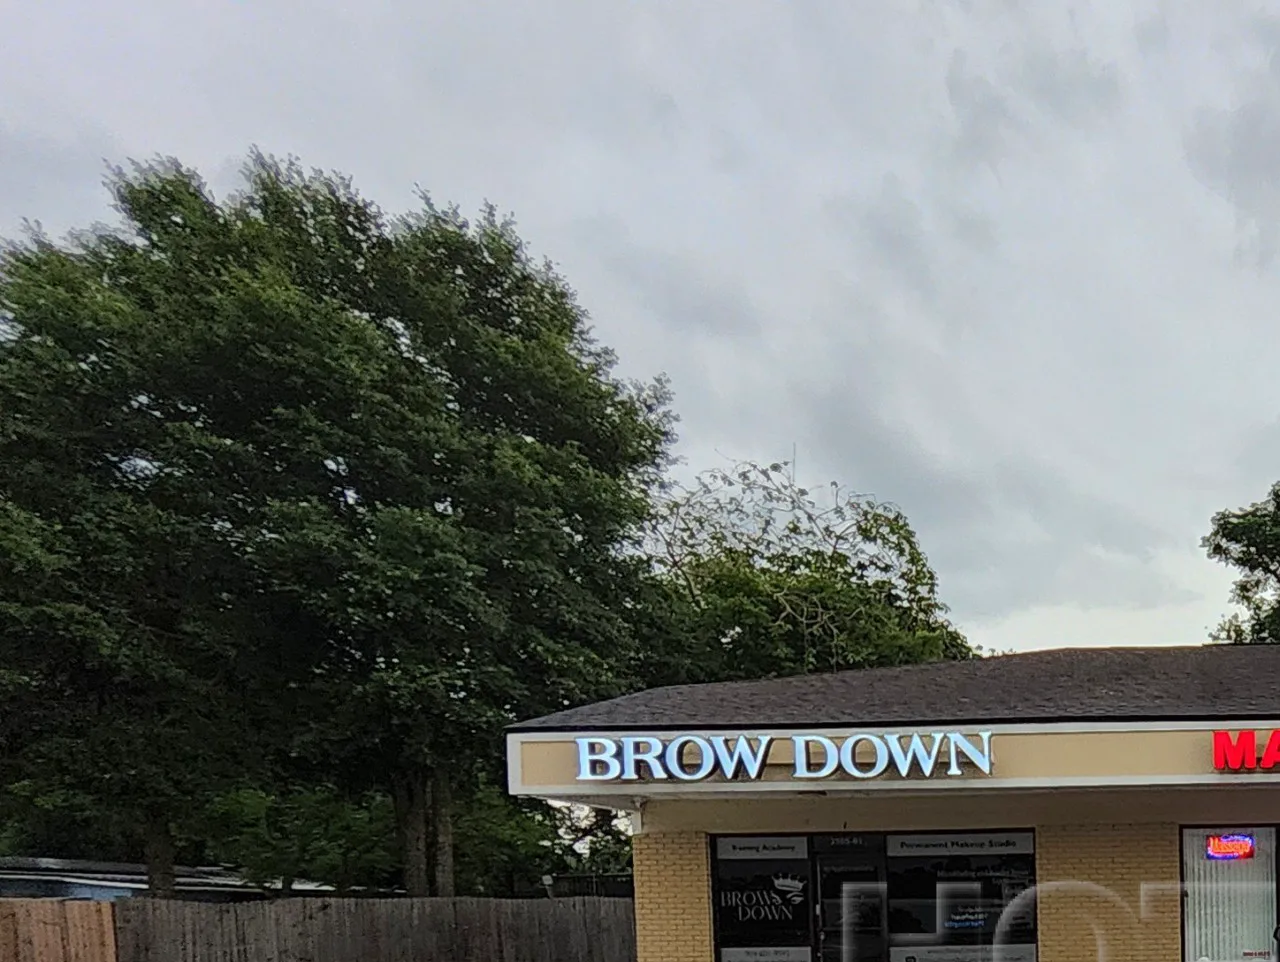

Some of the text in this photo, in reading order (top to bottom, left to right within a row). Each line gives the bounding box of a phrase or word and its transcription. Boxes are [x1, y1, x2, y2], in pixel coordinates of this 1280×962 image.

[574, 730, 993, 781] BROW DOWN
[738, 905, 793, 920] DOWN
